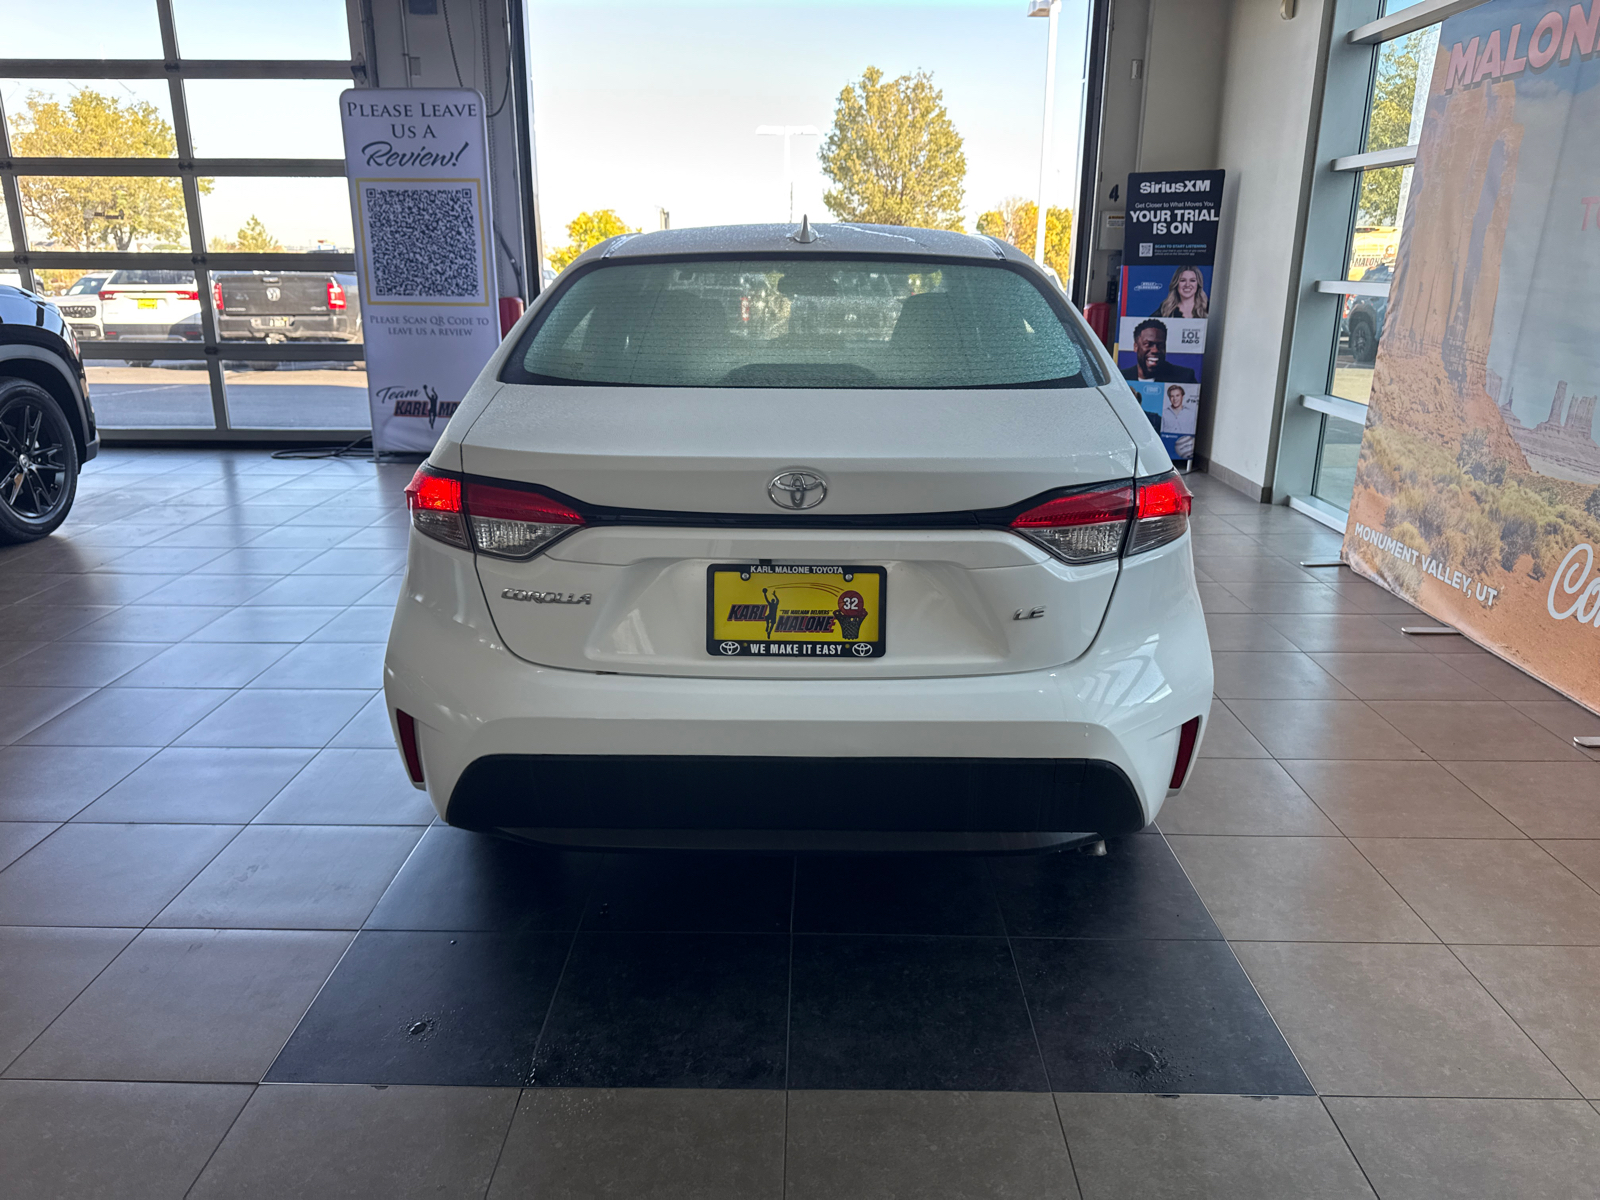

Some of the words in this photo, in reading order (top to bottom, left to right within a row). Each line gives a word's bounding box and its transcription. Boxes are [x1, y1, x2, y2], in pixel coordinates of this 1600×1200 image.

[347, 101, 414, 118] PLEASE
[420, 102, 477, 118] LEAVE
[391, 123, 416, 139] US
[422, 123, 437, 139] A
[361, 140, 469, 167] Review!
[1108, 183, 1120, 203] 4
[1139, 179, 1211, 194] SiriusXM
[1130, 210, 1171, 223] YOUR
[1174, 209, 1219, 222] TRIAL
[1152, 222, 1167, 235] IS
[1170, 222, 1193, 235] ON
[370, 315, 400, 325] PLEASE
[403, 315, 428, 325] SCAN
[430, 315, 445, 327] QR
[447, 315, 474, 326] CODE
[388, 327, 413, 336] LEAVE
[415, 327, 427, 336] US
[430, 327, 437, 336] A
[439, 328, 473, 336] REVIEW
[1181, 331, 1200, 340] LOL
[376, 385, 420, 404] Team
[394, 400, 430, 416] KARL
[750, 565, 773, 574] KARL
[775, 566, 810, 574] MALONE
[812, 566, 844, 575] TOYOTA
[1354, 522, 1420, 566] MONUMENT
[1421, 554, 1472, 599] VALLEY,
[1475, 584, 1498, 606] UT
[500, 587, 592, 605] COROLLA
[843, 597, 859, 610] 32
[727, 604, 769, 622] KARL
[1013, 605, 1047, 620] LE
[774, 615, 836, 633] MALONE
[750, 643, 766, 654] WE
[770, 643, 799, 654] MAKE
[803, 644, 813, 655] IT
[816, 644, 842, 655] EASY
